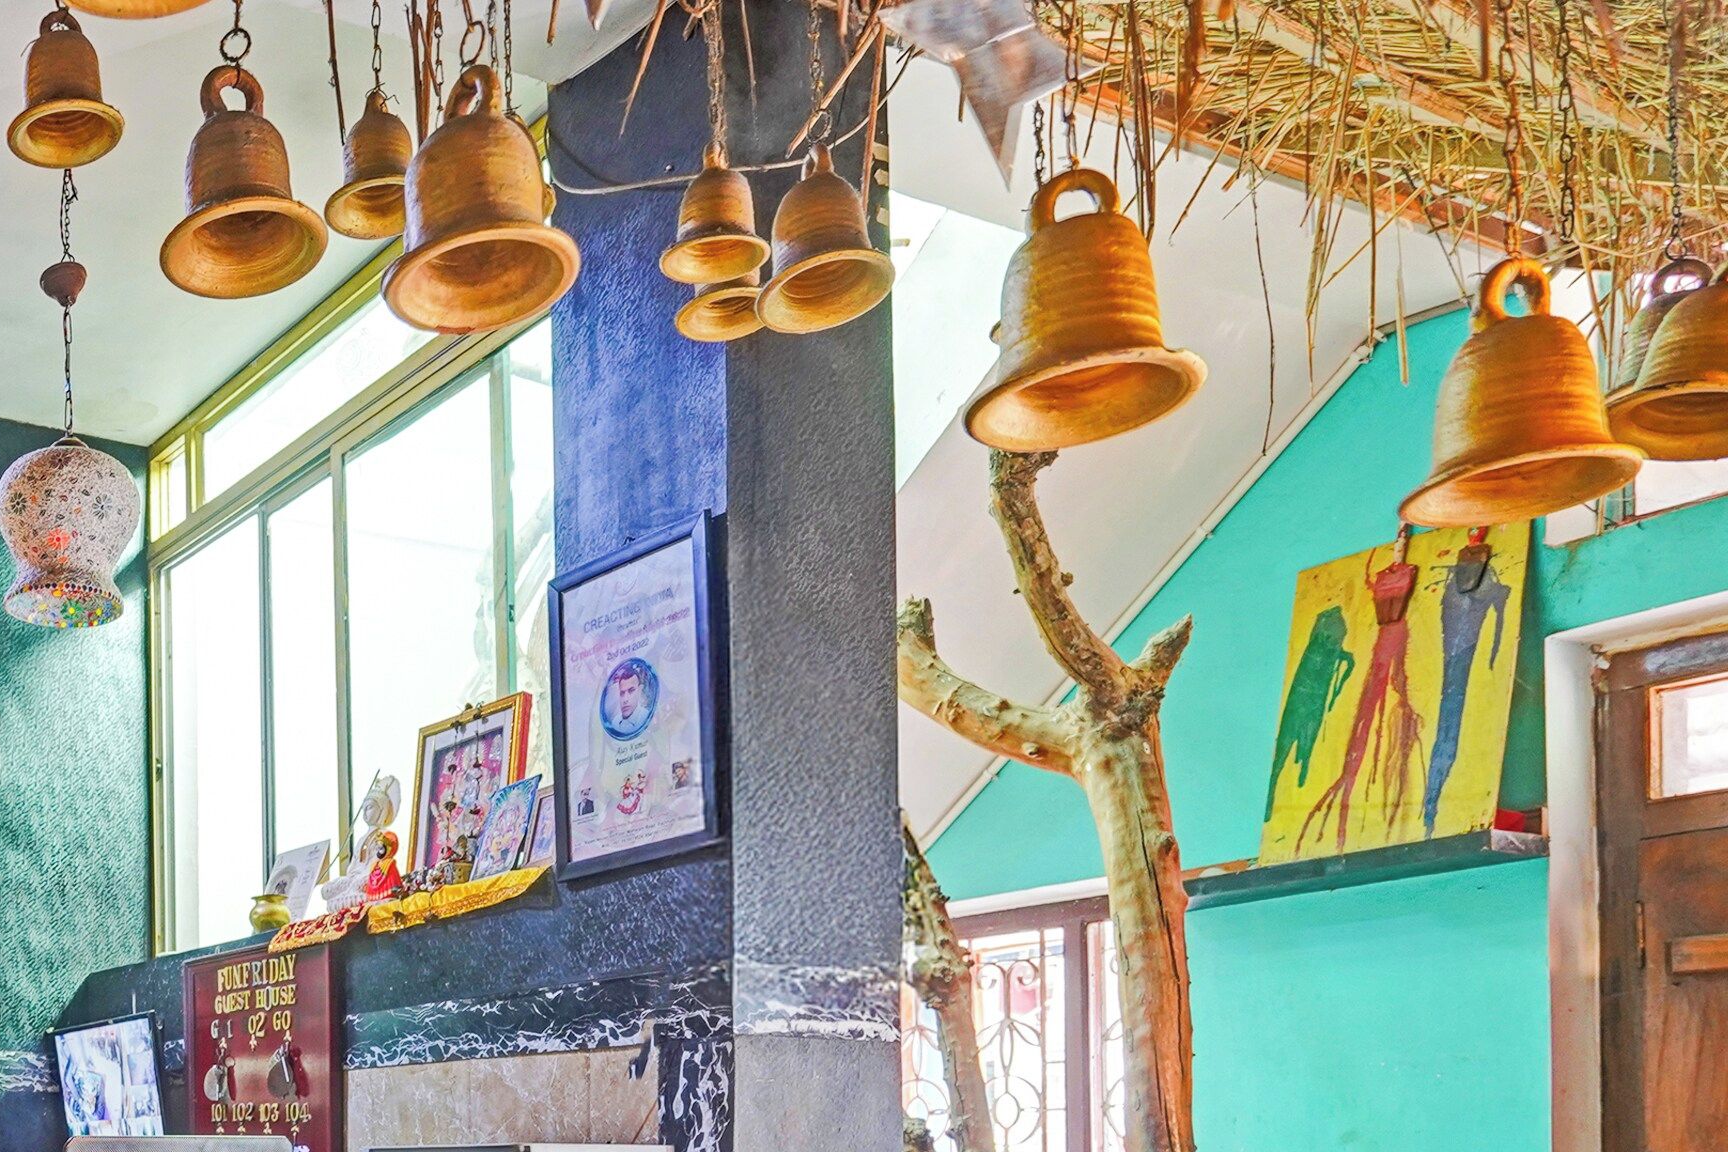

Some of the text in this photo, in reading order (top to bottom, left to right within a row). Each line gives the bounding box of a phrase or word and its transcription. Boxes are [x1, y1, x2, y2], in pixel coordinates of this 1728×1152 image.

[215, 984, 296, 1014] GUEST HOUSE
[211, 1104, 227, 1122] 101
[232, 1102, 254, 1121] 102
[259, 1102, 279, 1122] 103
